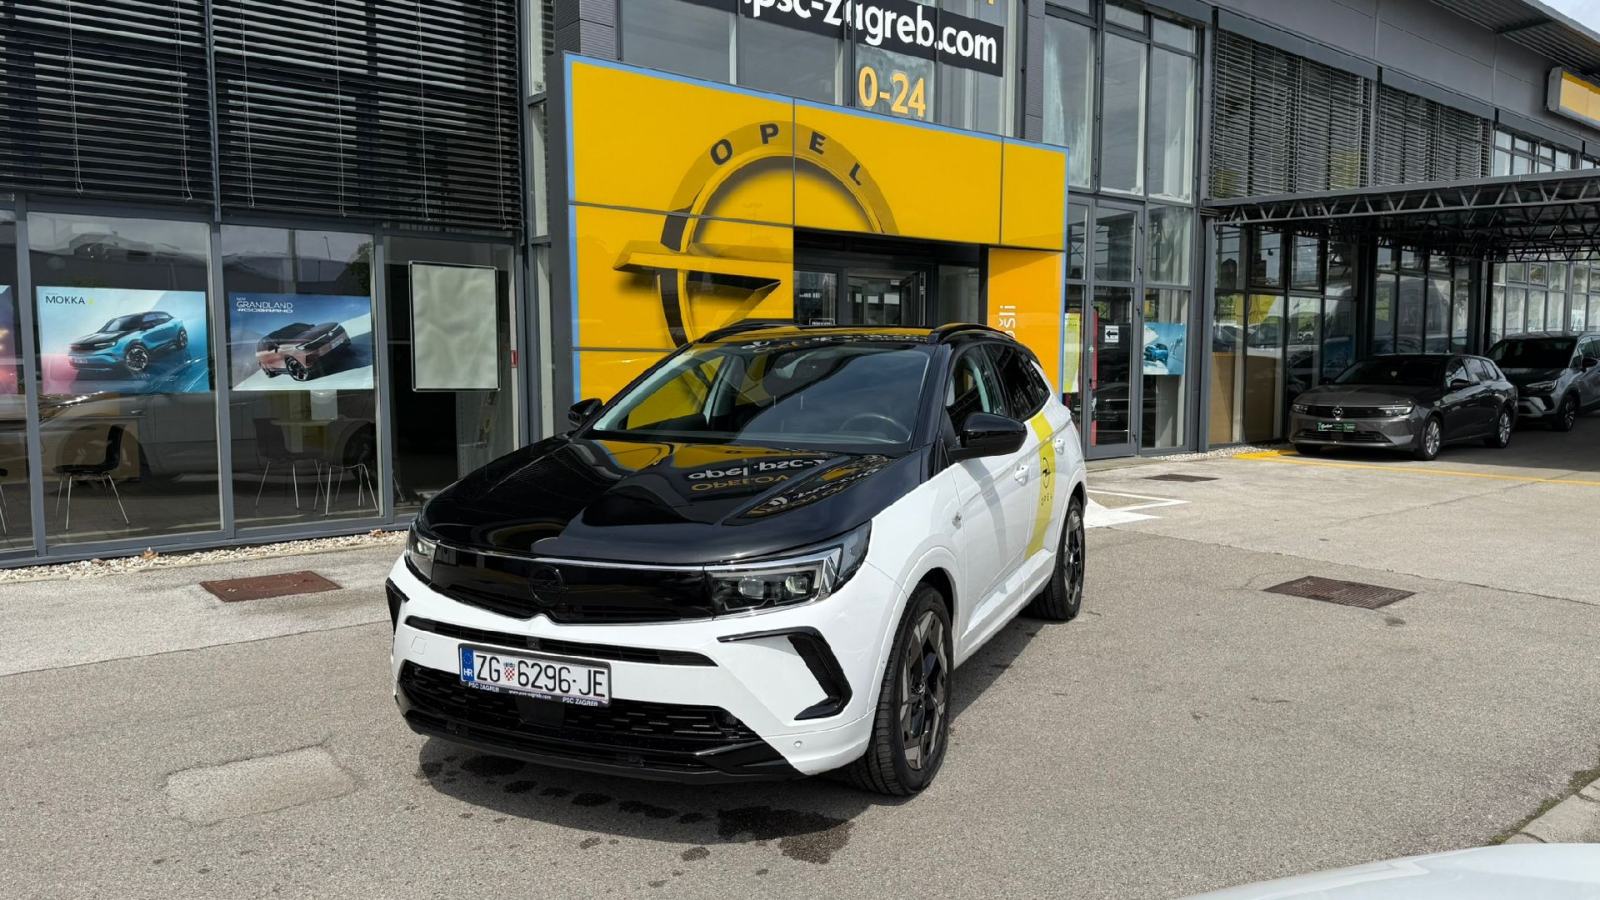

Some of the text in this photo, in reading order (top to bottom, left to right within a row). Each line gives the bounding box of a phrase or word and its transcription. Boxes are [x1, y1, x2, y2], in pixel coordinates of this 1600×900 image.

[857, 66, 926, 118] 0-24
[710, 123, 862, 186] OPEL
[45, 295, 85, 305] MOKKA
[236, 301, 293, 309] GRANDLAND
[463, 667, 474, 677] HR
[475, 654, 606, 697] ZG 6296-JE
[562, 697, 574, 705] PSC
